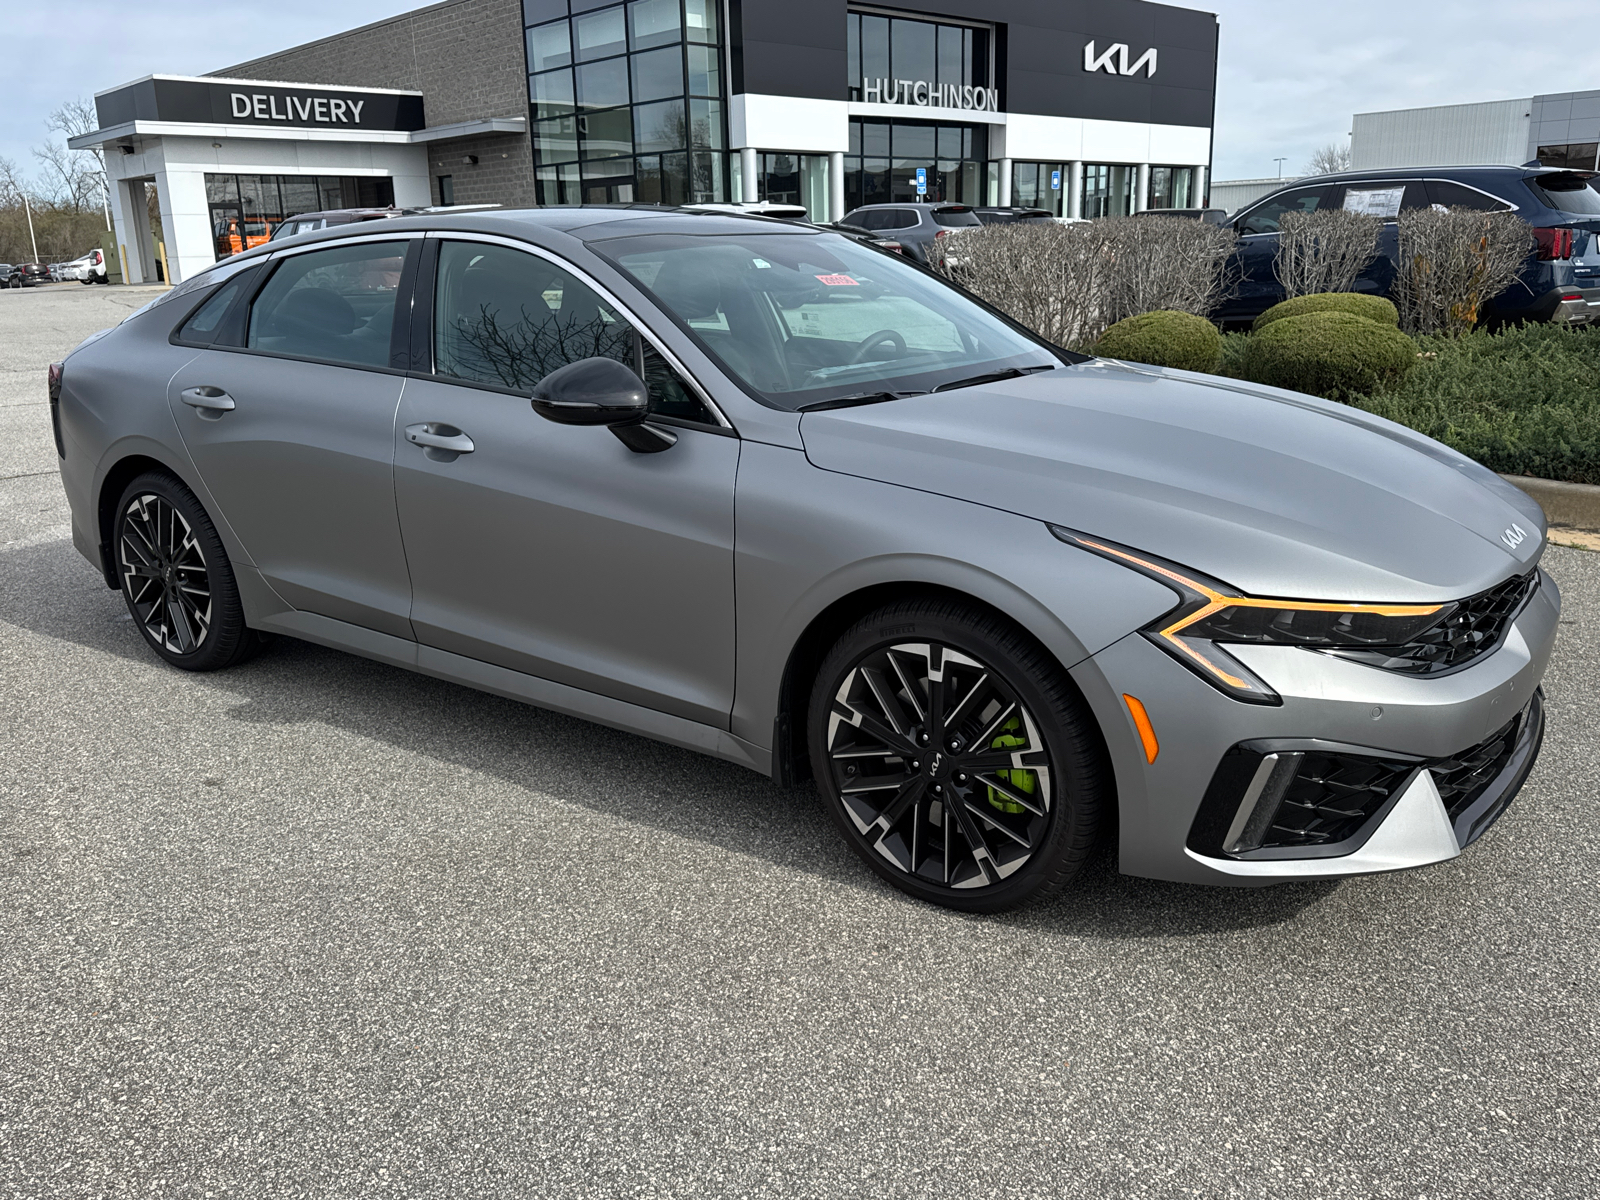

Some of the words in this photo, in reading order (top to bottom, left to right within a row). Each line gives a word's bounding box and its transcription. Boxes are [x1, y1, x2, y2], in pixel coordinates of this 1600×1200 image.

[1084, 39, 1158, 79] KIA
[230, 92, 365, 123] DELIVERY
[863, 77, 999, 112] HUTCHINSON
[1499, 522, 1528, 550] KIA
[879, 622, 916, 638] PIRELLI
